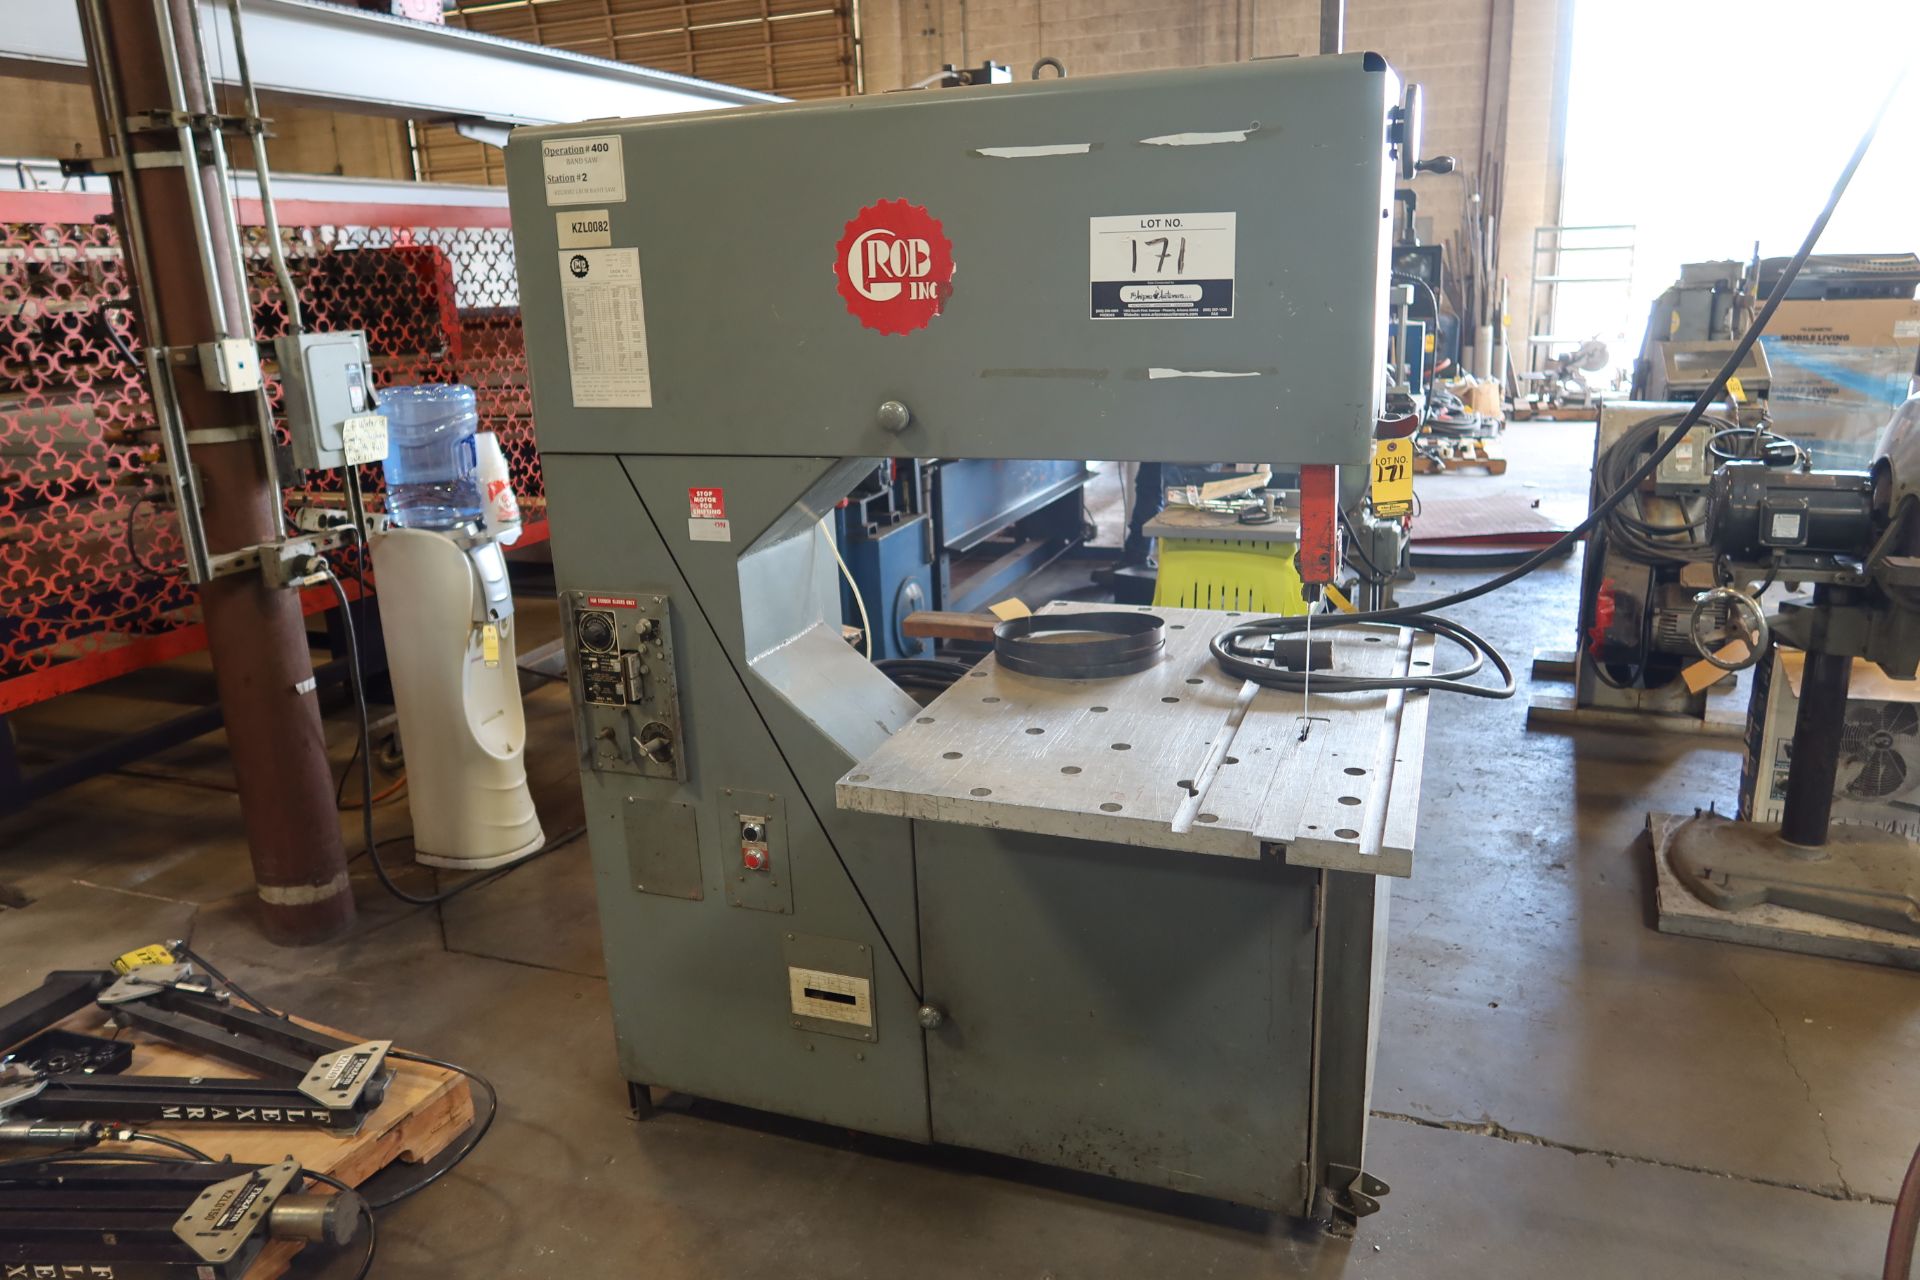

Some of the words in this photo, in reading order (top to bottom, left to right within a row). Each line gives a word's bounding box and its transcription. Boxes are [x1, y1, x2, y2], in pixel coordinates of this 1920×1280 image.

[544, 145, 584, 157] Operation
[546, 174, 575, 184] Station
[571, 221, 608, 233] KZL0082
[1140, 219, 1162, 229] LOT
[1164, 218, 1183, 228] NO.
[1131, 236, 1186, 275] 171
[909, 281, 938, 300] INC
[1375, 457, 1391, 466] LOT
[1394, 455, 1408, 464] NO.
[1378, 465, 1404, 482] 171
[162, 1106, 332, 1125] FLEXARM
